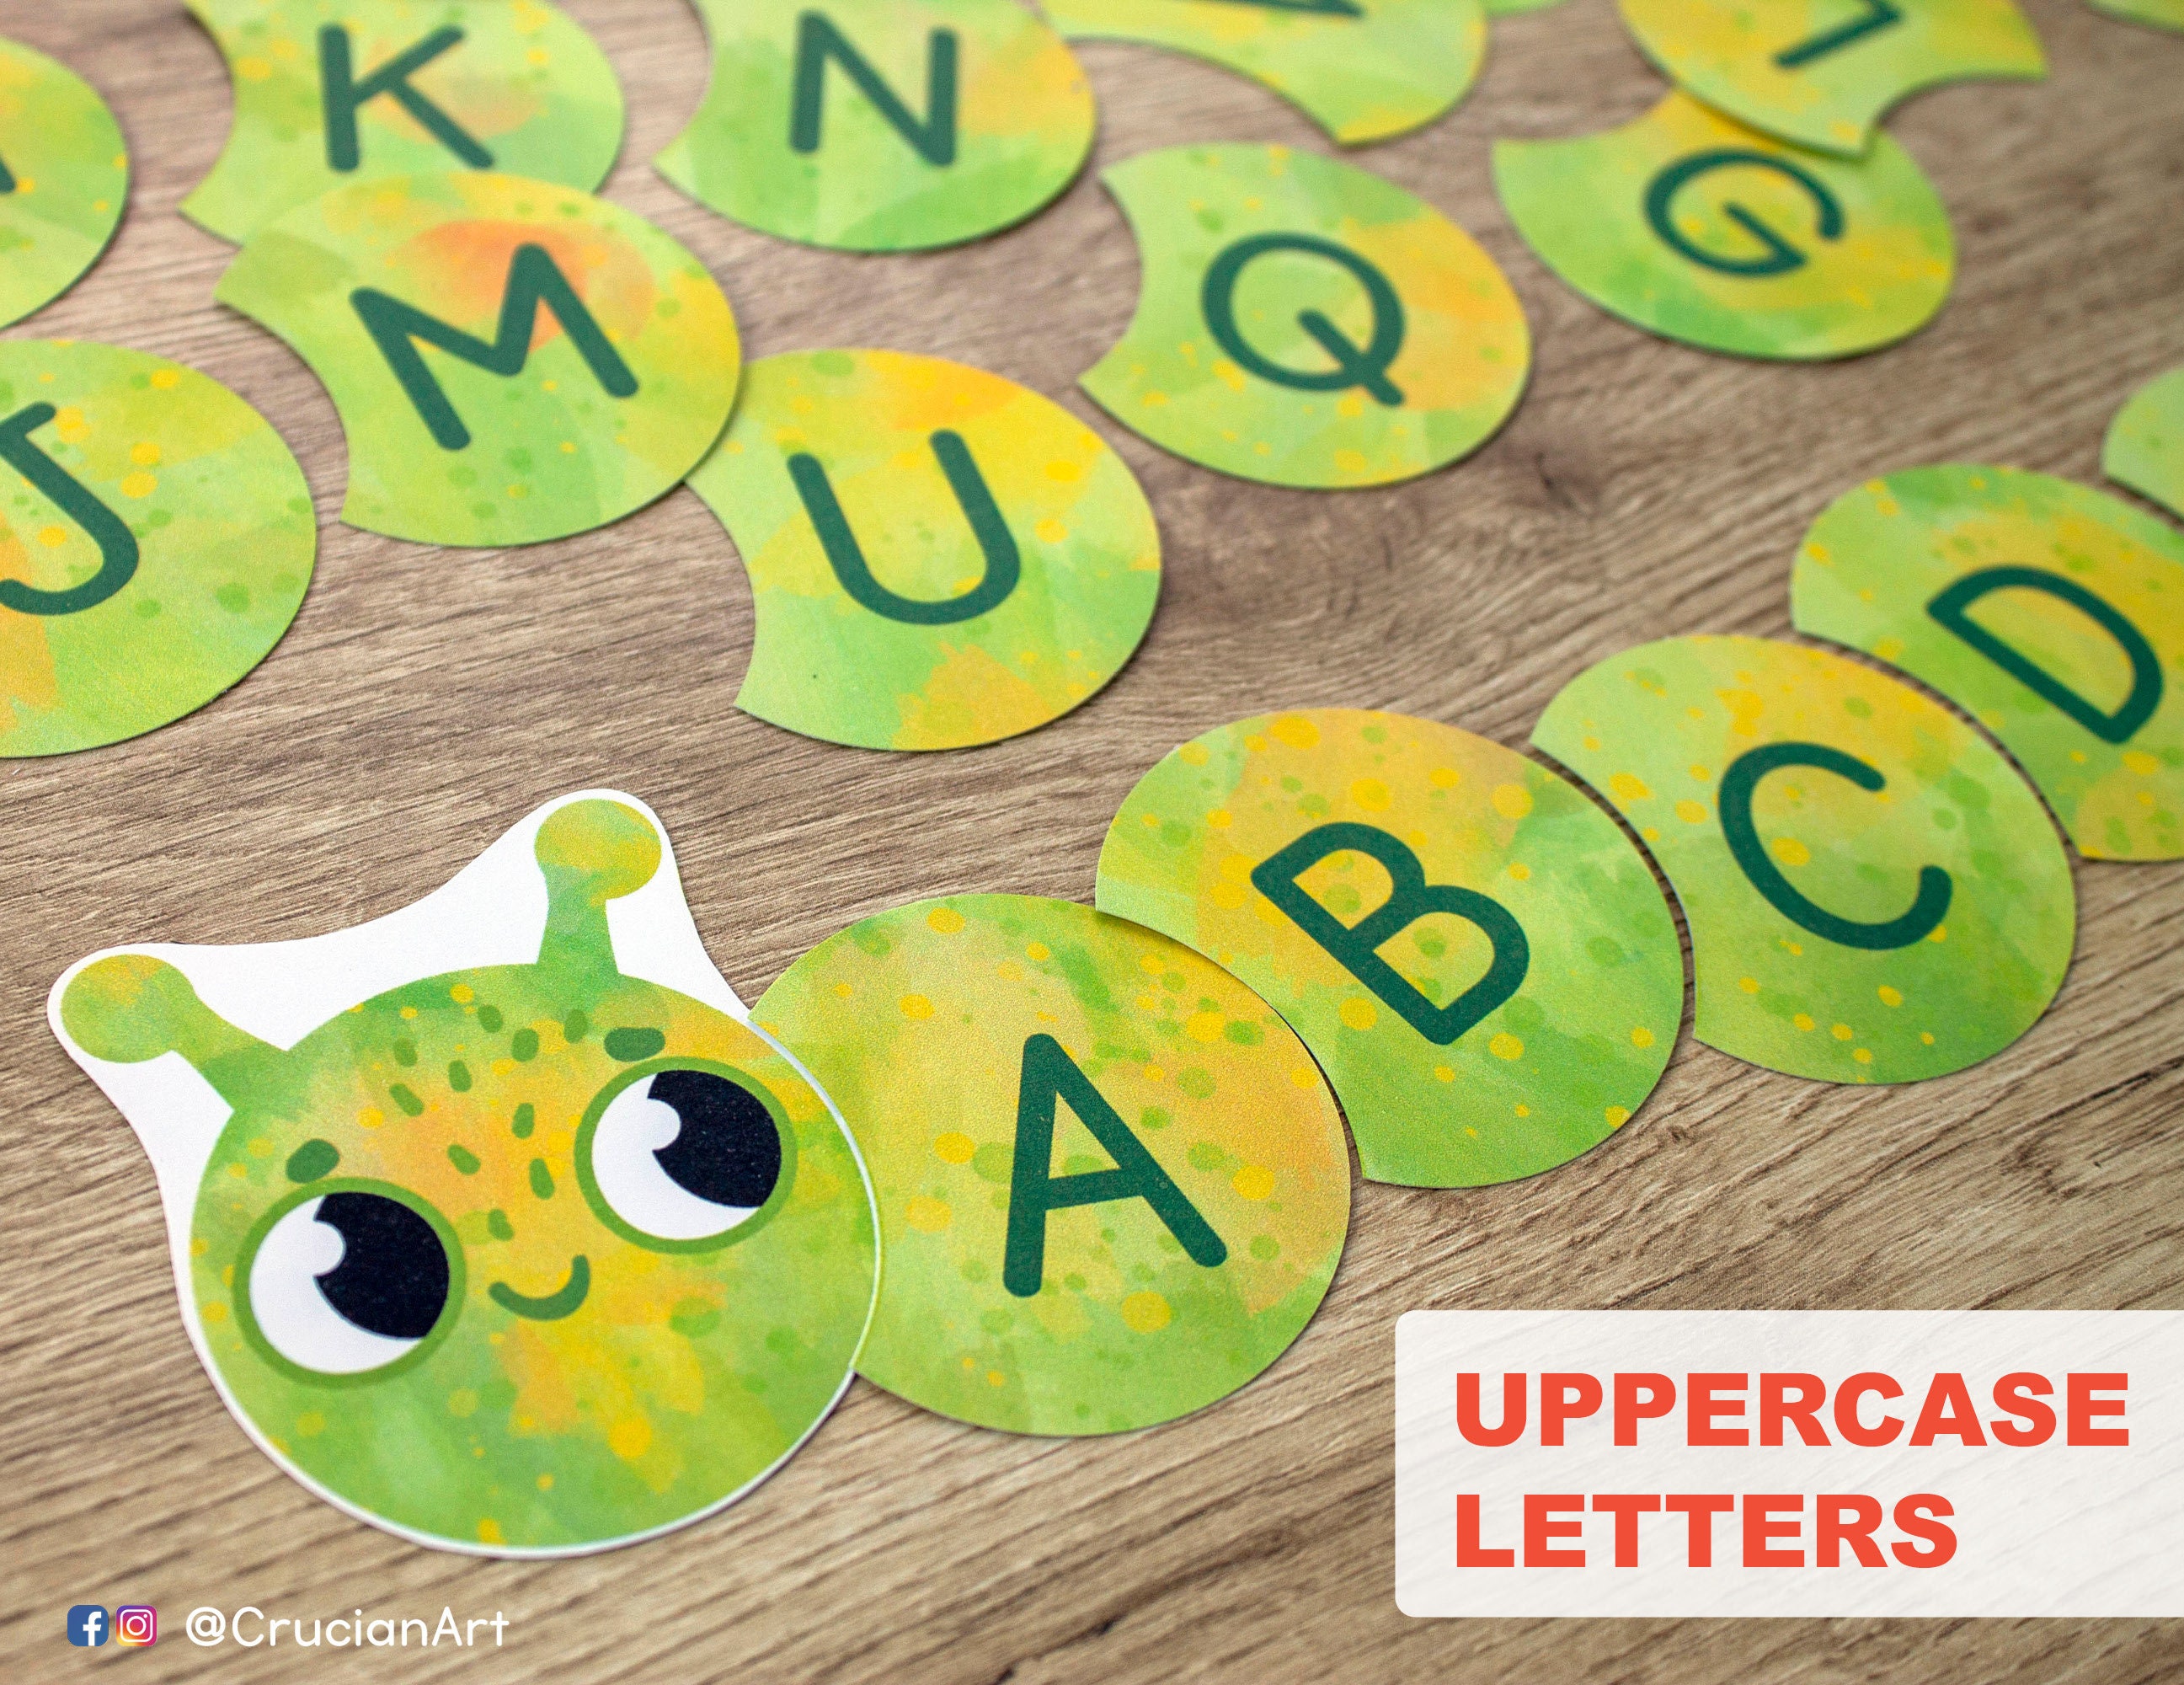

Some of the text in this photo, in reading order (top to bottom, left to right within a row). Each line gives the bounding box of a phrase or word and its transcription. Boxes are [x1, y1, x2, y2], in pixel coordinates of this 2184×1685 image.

[318, 22, 495, 174] K
[788, 8, 959, 168] N
[1642, 147, 1846, 278] G
[349, 242, 640, 452] M
[1200, 232, 1406, 408] Q
[787, 430, 1023, 626] U
[1925, 564, 2165, 747] D
[1250, 821, 1530, 1046] B
[1717, 741, 1955, 952] C
[1001, 1032, 1229, 1298] A
